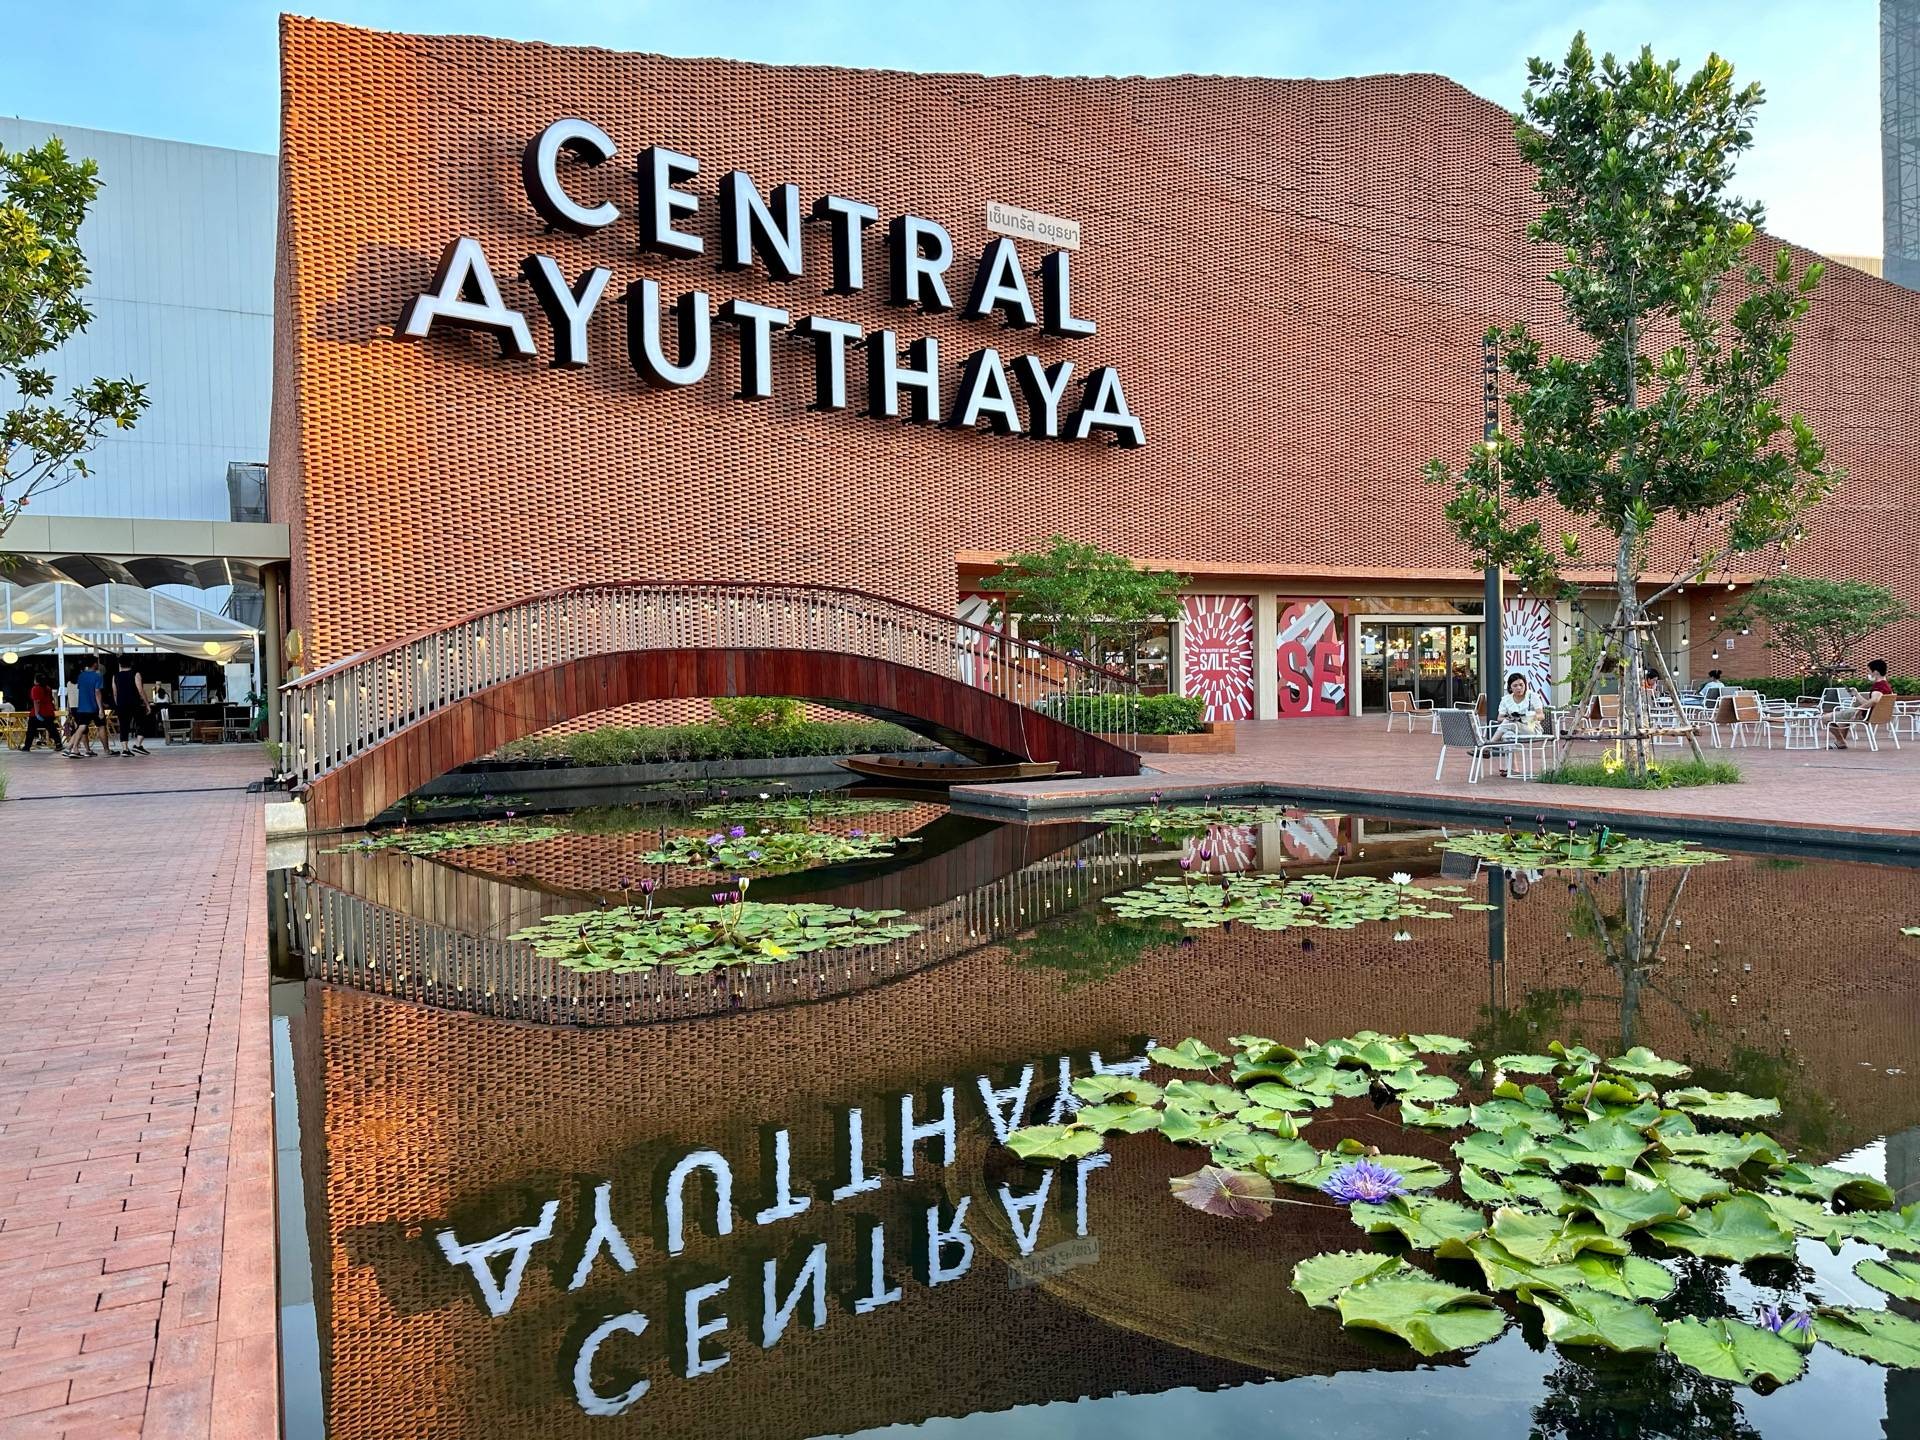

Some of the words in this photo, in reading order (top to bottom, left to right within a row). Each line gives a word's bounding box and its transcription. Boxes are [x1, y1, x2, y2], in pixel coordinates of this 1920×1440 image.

[524, 117, 1097, 338] CENTRAL
[1038, 222, 1078, 242] อยุธยา
[404, 236, 1147, 448] AYUTTHAYA
[1199, 653, 1229, 671] SALE
[1505, 649, 1531, 667] SALE
